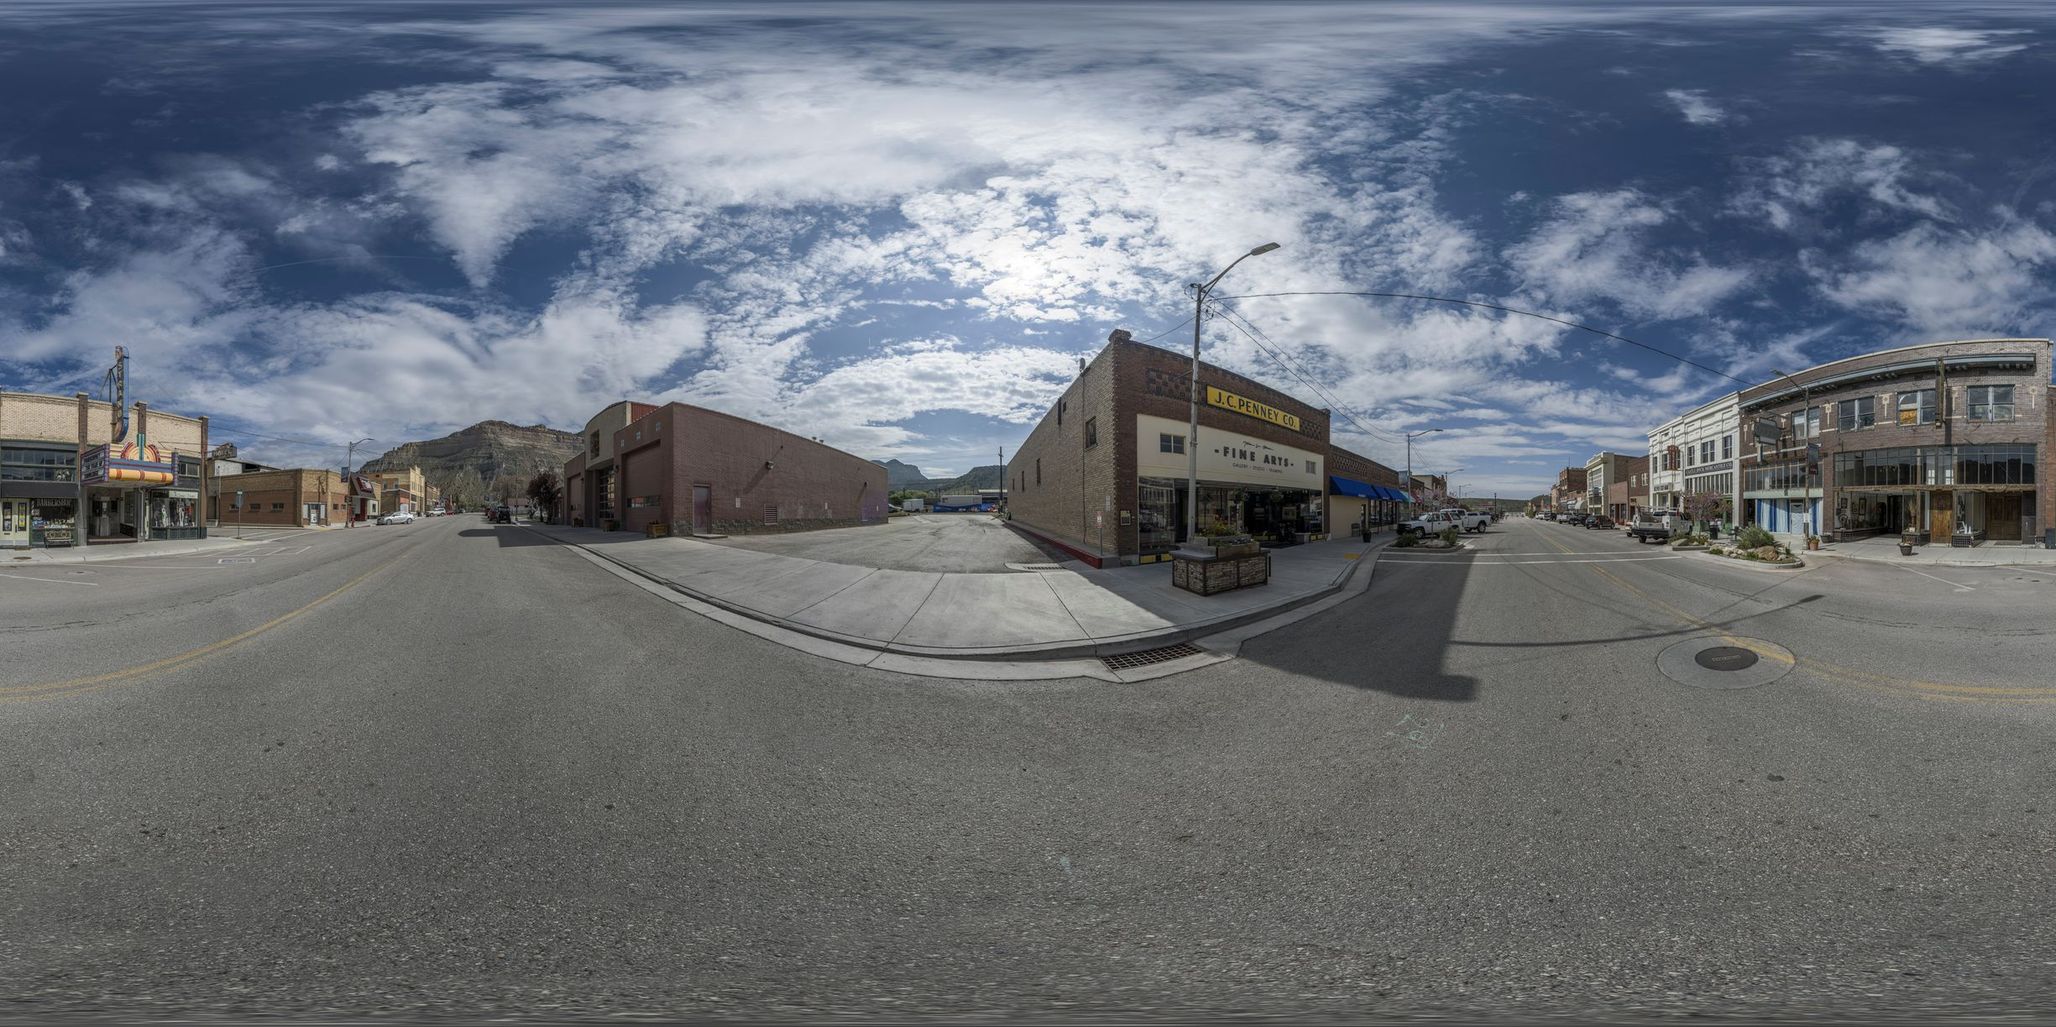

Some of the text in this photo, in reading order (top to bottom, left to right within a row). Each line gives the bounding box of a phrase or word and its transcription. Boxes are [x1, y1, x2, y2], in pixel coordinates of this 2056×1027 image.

[1282, 414, 1296, 428] CO.
[1223, 446, 1289, 468] FINE ARTS
